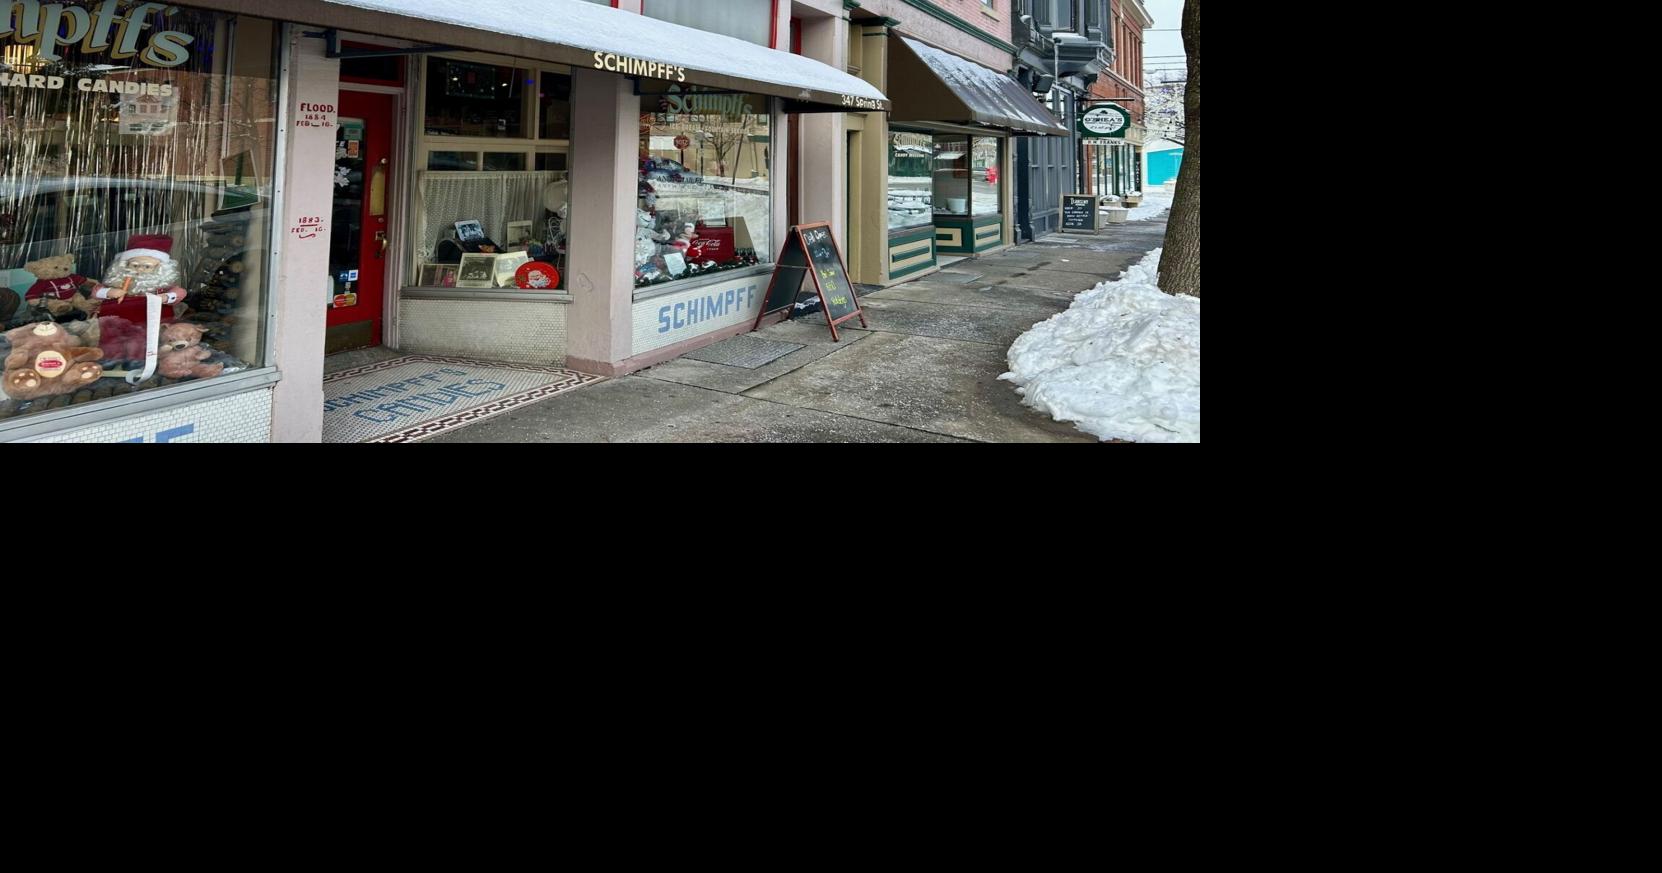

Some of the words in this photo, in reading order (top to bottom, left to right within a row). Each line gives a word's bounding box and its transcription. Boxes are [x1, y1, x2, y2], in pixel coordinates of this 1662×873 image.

[593, 51, 686, 82] SCHIMPFF'S
[77, 78, 172, 97] CANDIES
[300, 103, 336, 113] FLOOD.
[841, 94, 855, 106] 347
[855, 96, 876, 109] Spring
[657, 285, 757, 333] SCHIMPFF
[352, 378, 506, 423] CANDIES
